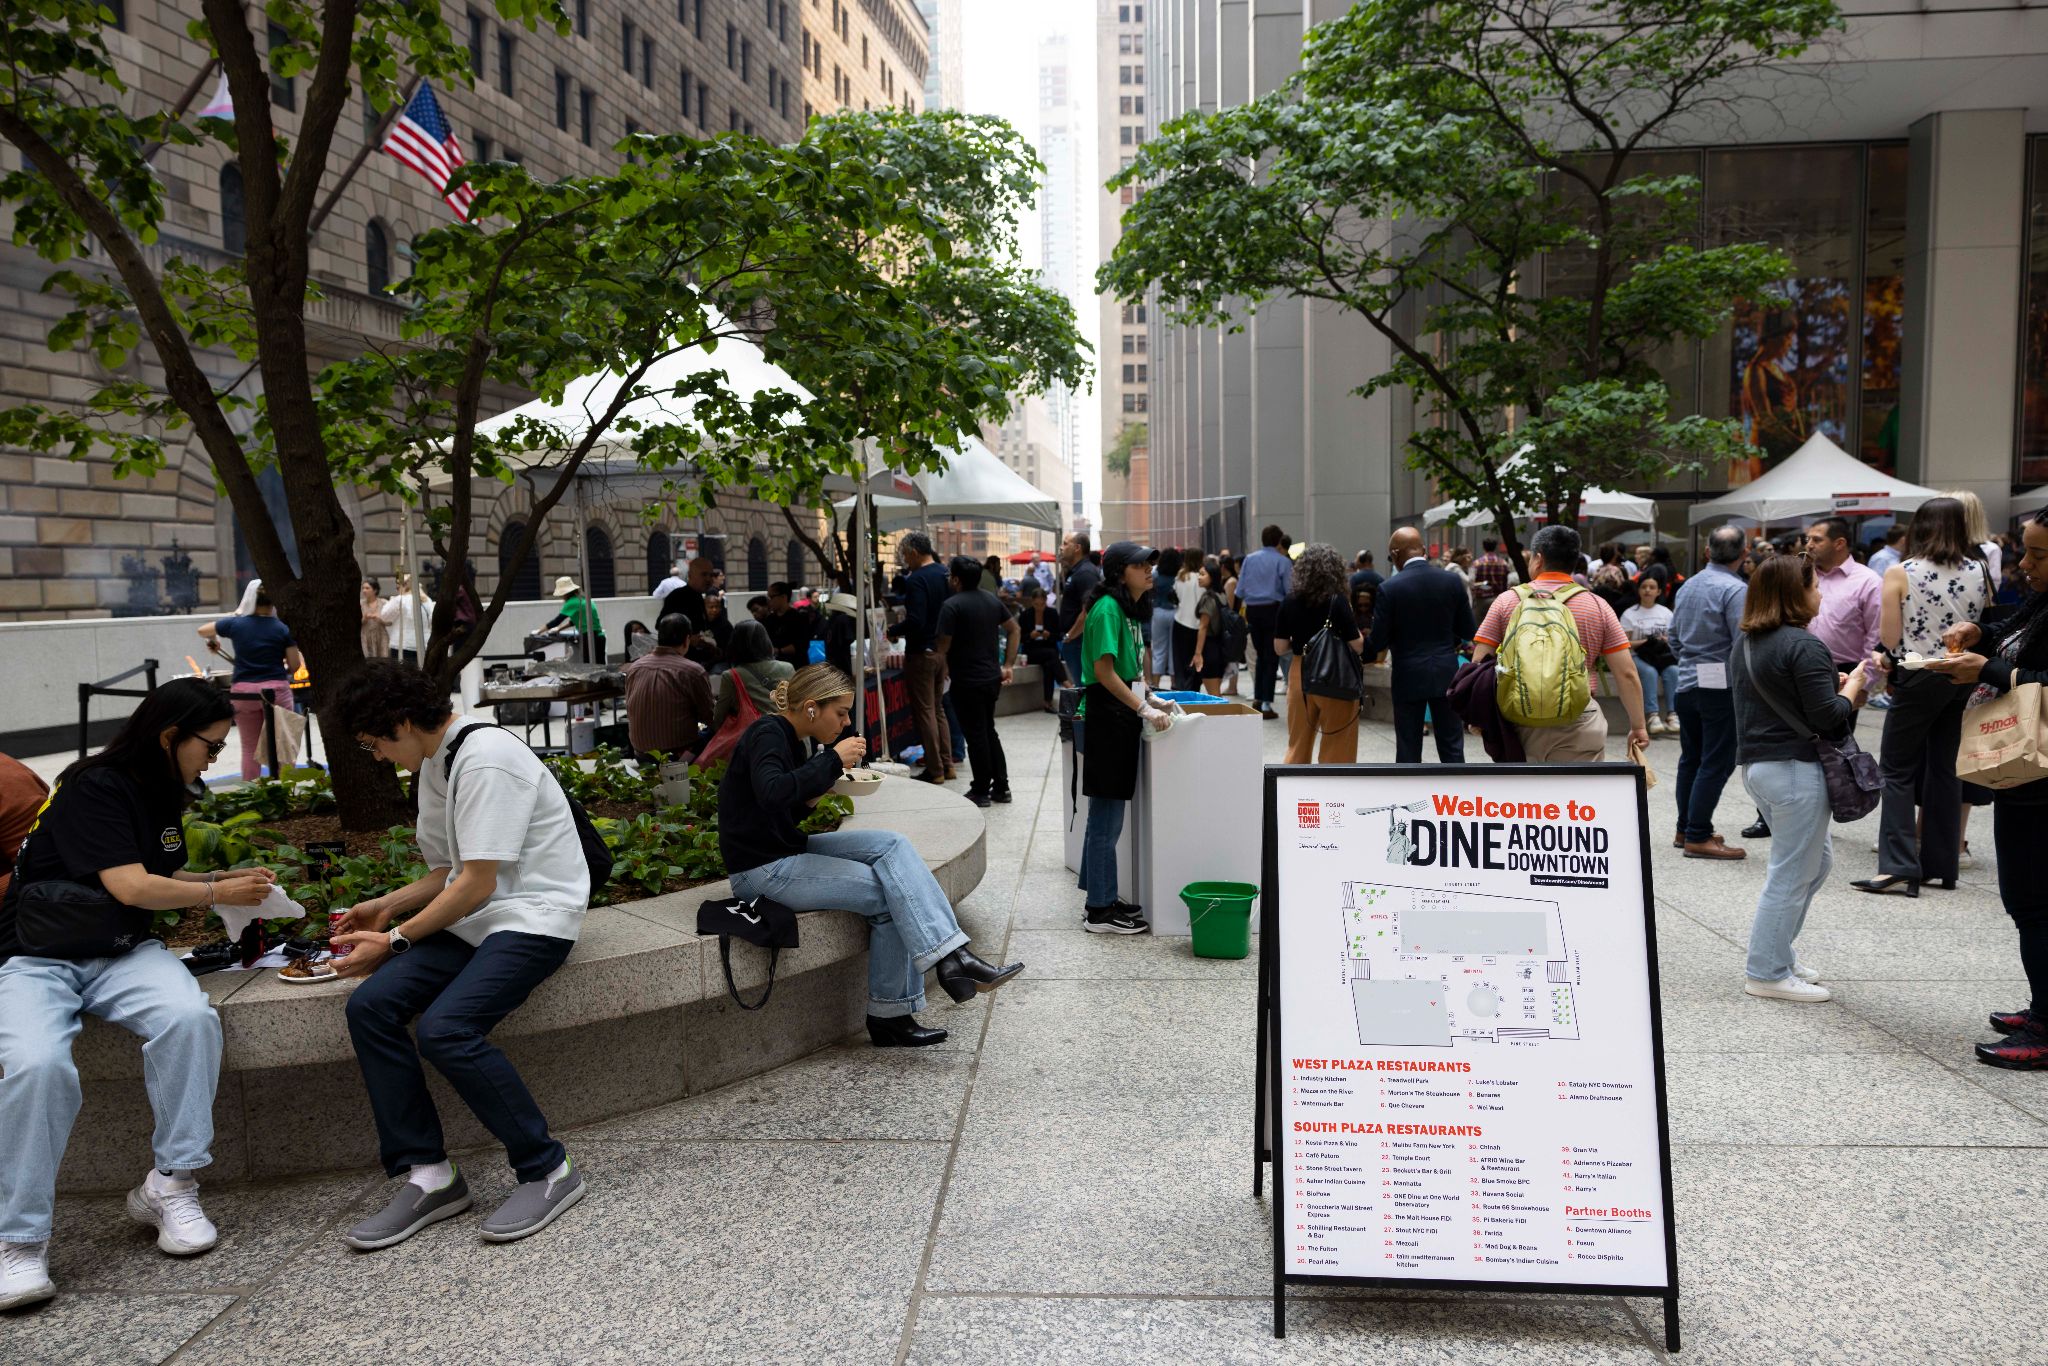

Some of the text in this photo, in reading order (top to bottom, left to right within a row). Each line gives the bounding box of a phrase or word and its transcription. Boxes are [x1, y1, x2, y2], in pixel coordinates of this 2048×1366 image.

[1298, 807, 1319, 815] DOWN
[1432, 795, 1596, 821] Welcome to
[1410, 819, 1505, 870] DINE
[1508, 824, 1608, 853] AROUND
[1508, 852, 1608, 875] DOWNTOWN
[1292, 1059, 1471, 1073] WEST PLAZA RESTAURANTS
[1294, 1121, 1482, 1137] SOUTH PLAZA RESTAURANTS
[1565, 1205, 1652, 1218] Partner Booths
